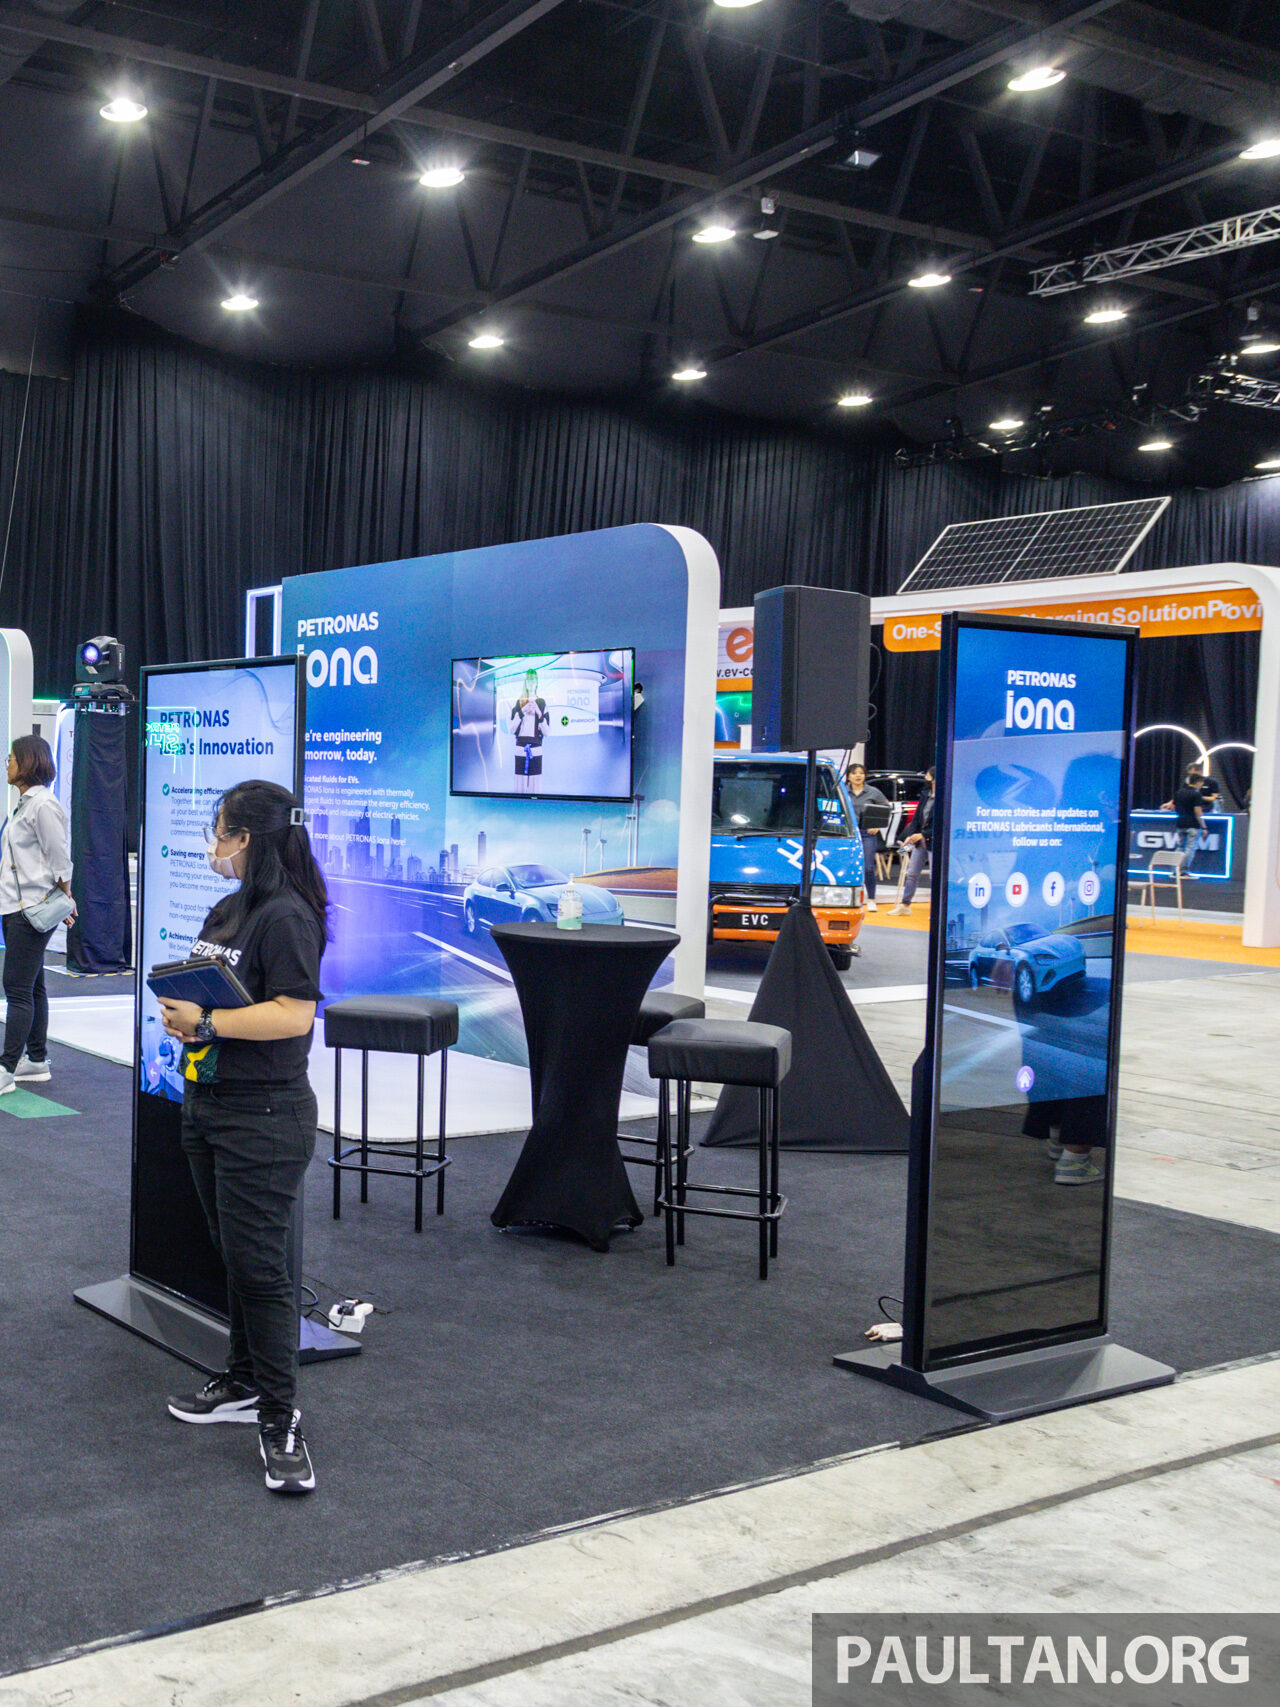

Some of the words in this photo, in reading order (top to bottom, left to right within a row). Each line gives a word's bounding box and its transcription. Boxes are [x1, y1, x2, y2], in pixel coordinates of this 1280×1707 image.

[1112, 603, 1206, 624] Solution
[297, 611, 379, 637] PETRONAS
[1007, 670, 1077, 688] PETRONAS
[1006, 690, 1075, 730] iona
[160, 709, 230, 728] PETRONAS
[305, 729, 322, 742] e're
[323, 729, 382, 745] engineering
[199, 738, 274, 755] Innovation
[305, 750, 344, 762] morrow,
[346, 748, 377, 764] today.
[341, 787, 372, 796] engineered
[386, 789, 414, 799] thermally
[368, 799, 378, 807] the
[379, 801, 399, 810] energy
[373, 811, 394, 819] electric
[976, 807, 990, 817] For
[991, 808, 1012, 817] more
[1013, 807, 1040, 817] stories
[1041, 808, 1056, 817] and
[1057, 808, 1087, 819] updates
[1088, 810, 1099, 818] on
[967, 821, 1010, 832] PETRONAS
[1011, 822, 1052, 832] Lubricants
[345, 834, 376, 843] PETRONAS
[1012, 837, 1038, 847] follow
[1039, 838, 1048, 846] us
[1137, 831, 1220, 851] GWM
[170, 849, 187, 858] Saving
[187, 852, 205, 860] energy
[742, 914, 769, 925] EVC
[169, 932, 194, 943] Achieving
[192, 940, 242, 966] ETRONAS
